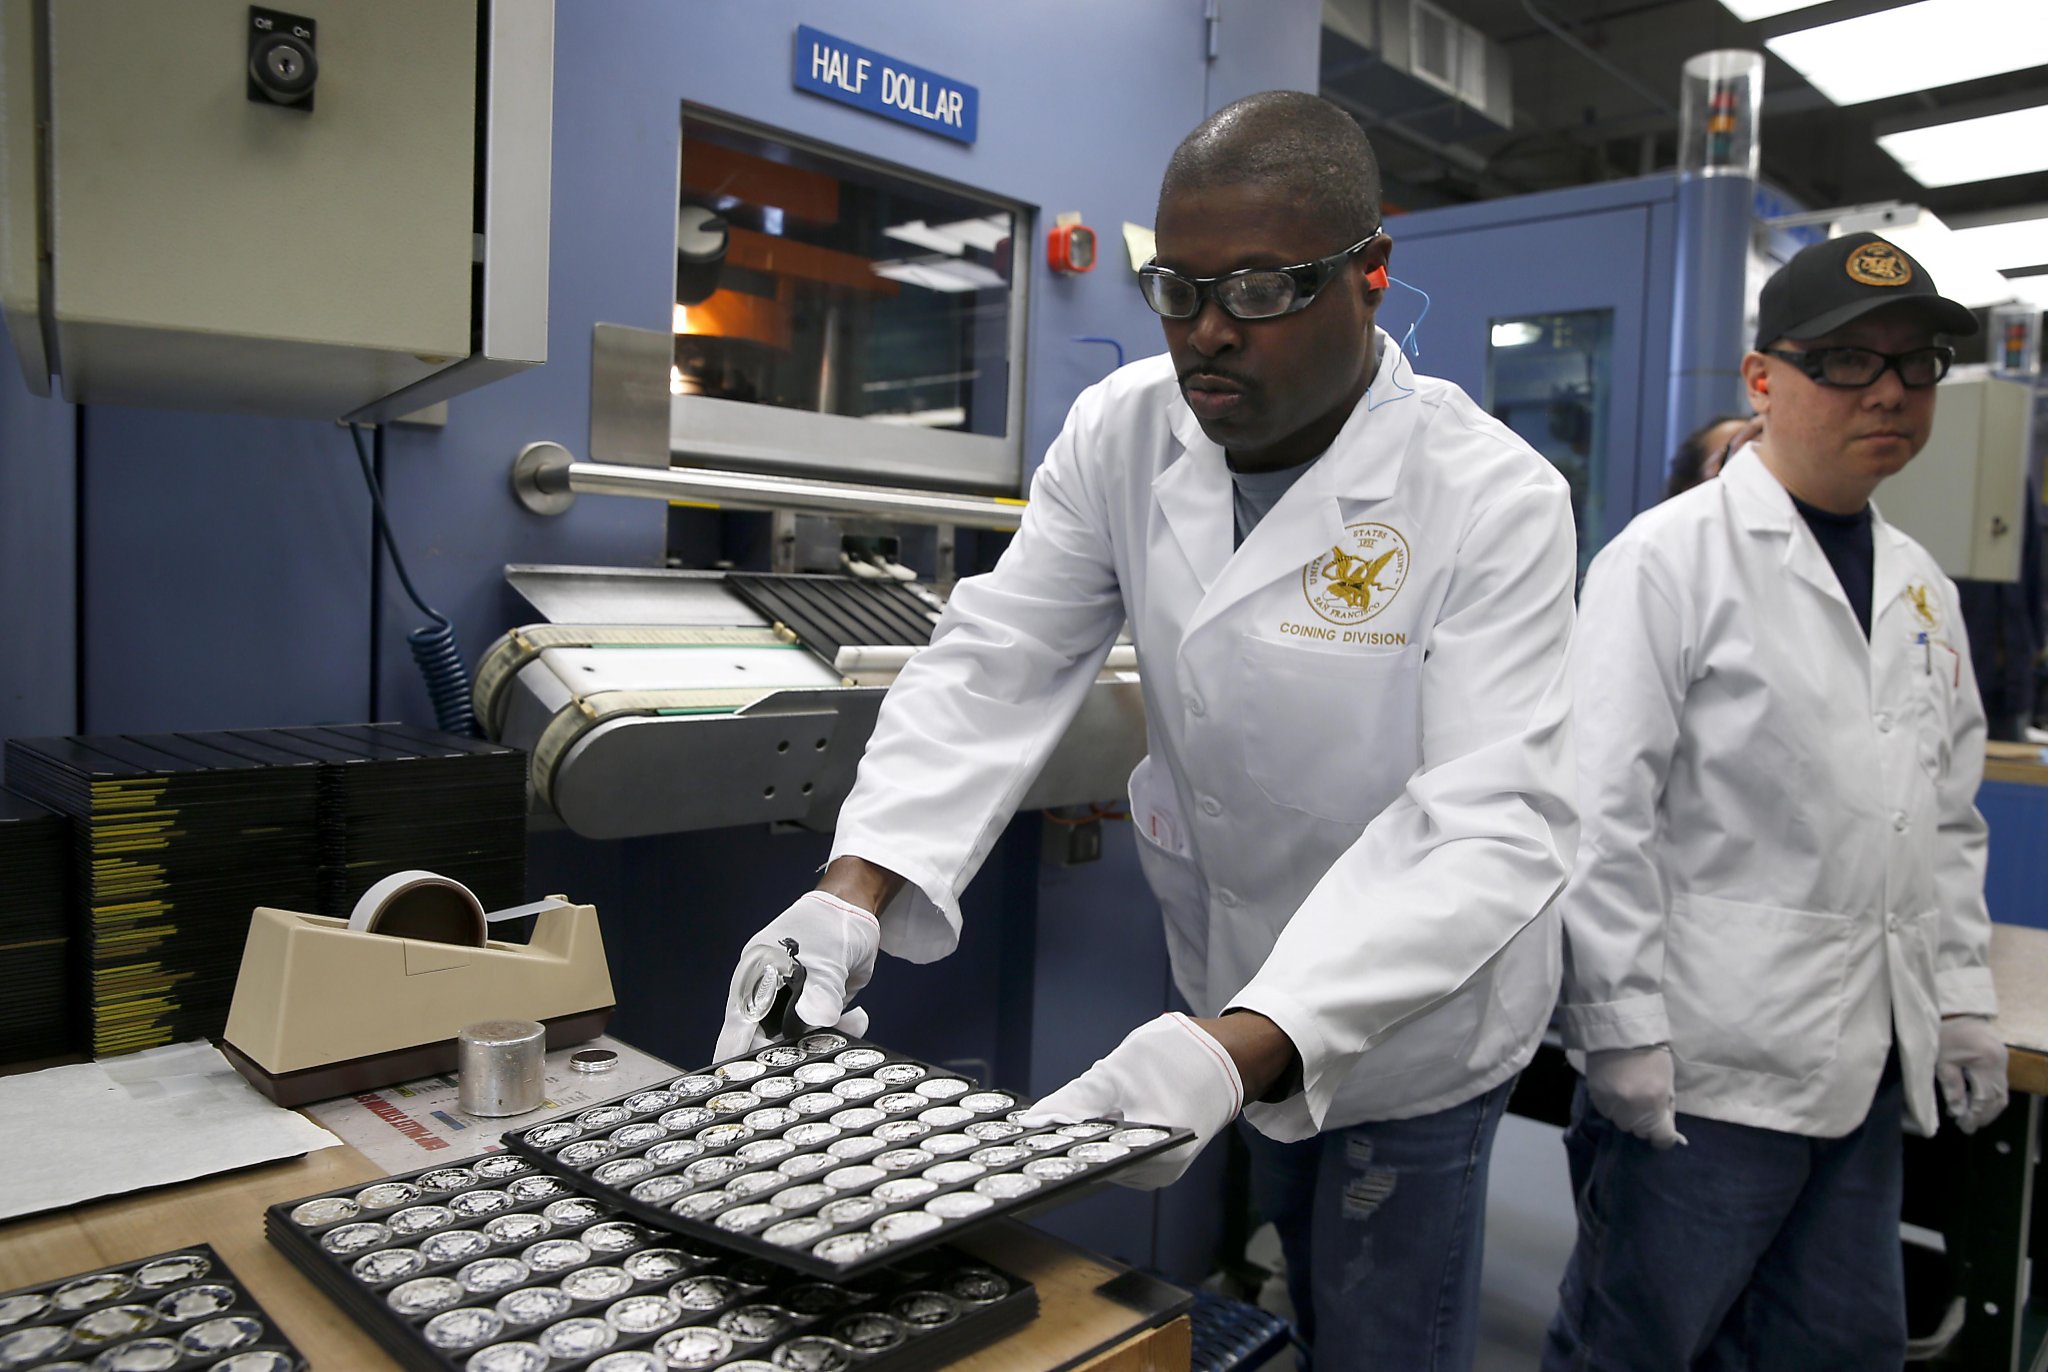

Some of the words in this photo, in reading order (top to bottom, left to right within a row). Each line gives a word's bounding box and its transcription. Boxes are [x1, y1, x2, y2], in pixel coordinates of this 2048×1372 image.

[254, 17, 273, 30] Off
[292, 25, 311, 39] On
[811, 42, 872, 95] HALF
[881, 66, 964, 129] DOLLAR
[1353, 529, 1388, 539] STATES
[1396, 549, 1404, 573] MINT
[1314, 597, 1329, 611] SAN
[1330, 602, 1380, 619] FRANCISCO
[1279, 622, 1336, 640] COINING
[1342, 631, 1407, 645] DIVISION
